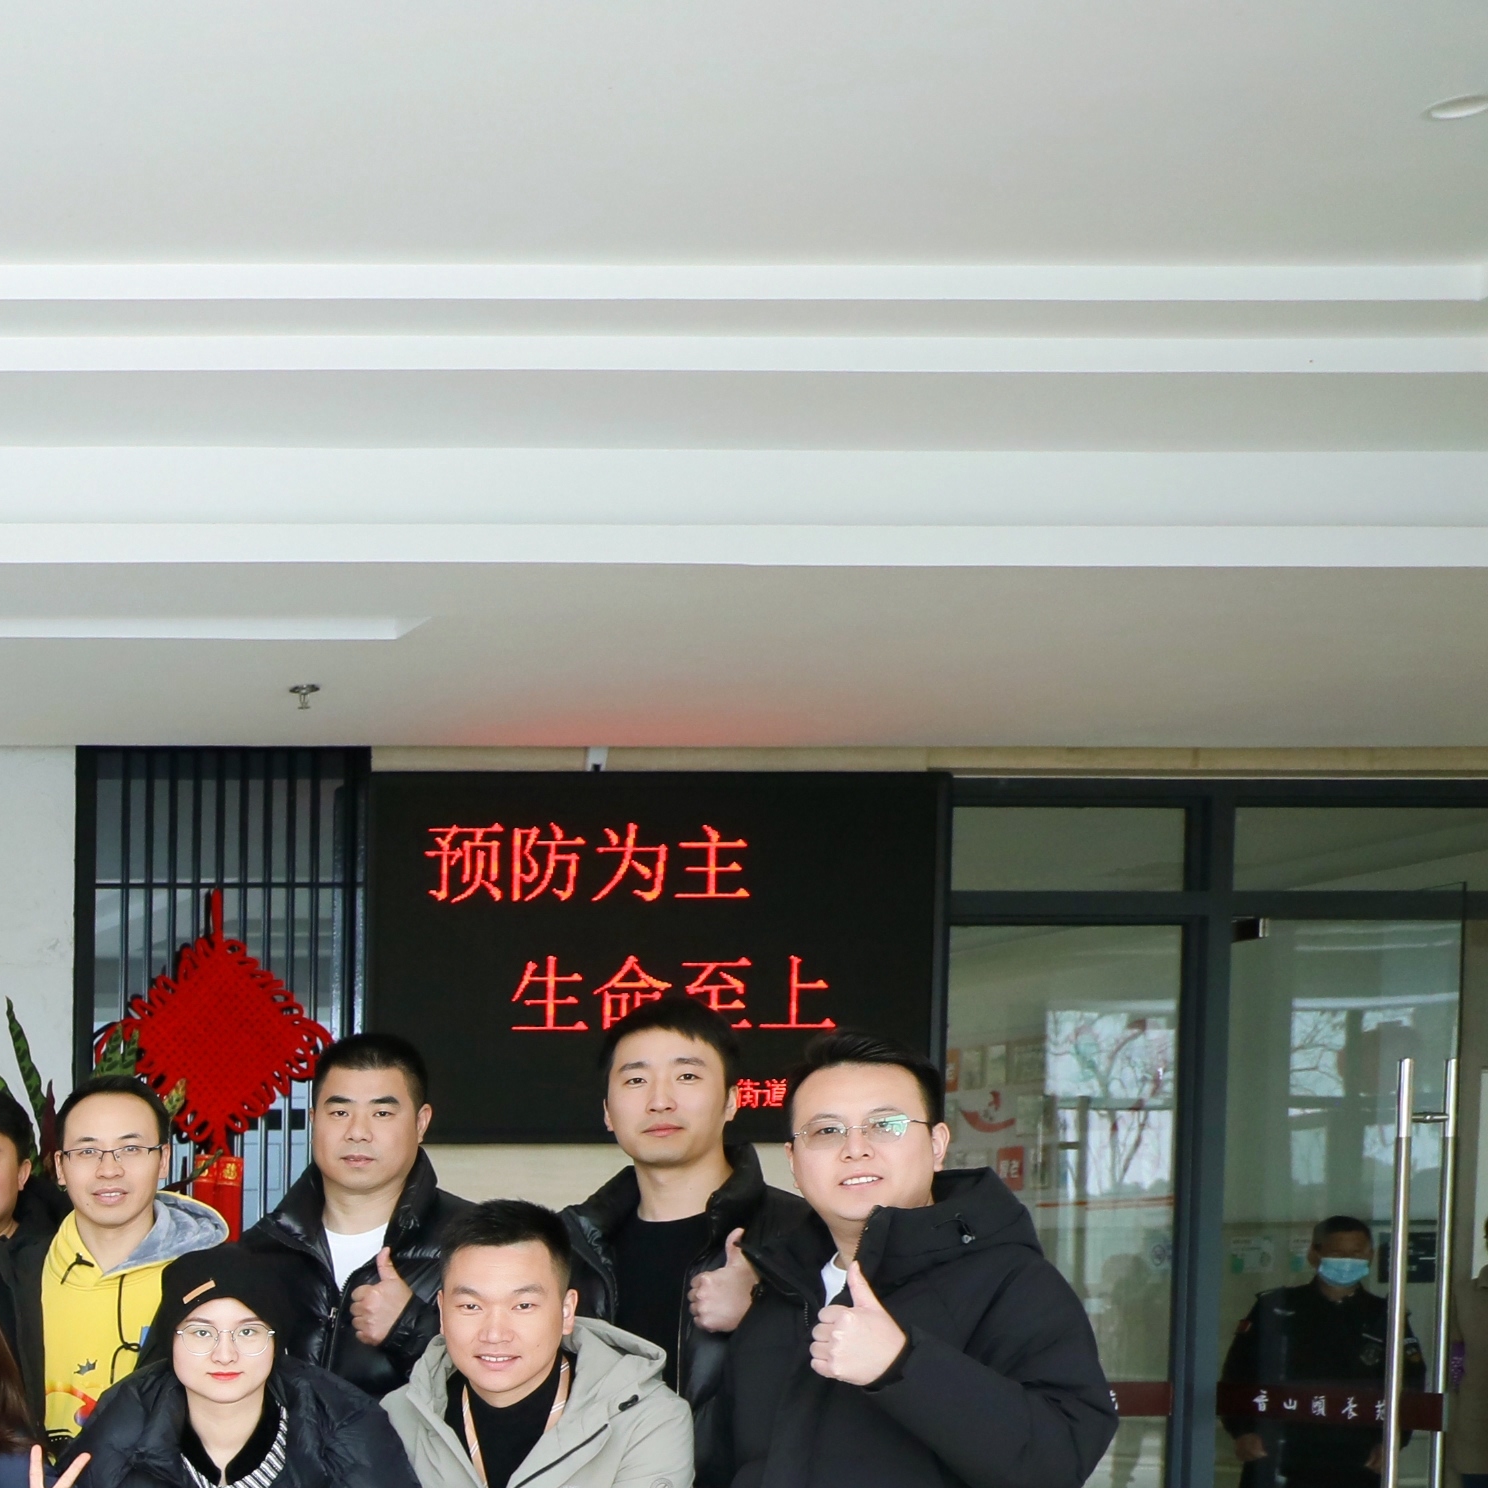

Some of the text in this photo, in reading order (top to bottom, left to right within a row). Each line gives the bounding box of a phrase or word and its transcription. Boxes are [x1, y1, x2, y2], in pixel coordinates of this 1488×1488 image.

[425, 822, 750, 903] 预防为主
[511, 955, 837, 1032] 生命至上
